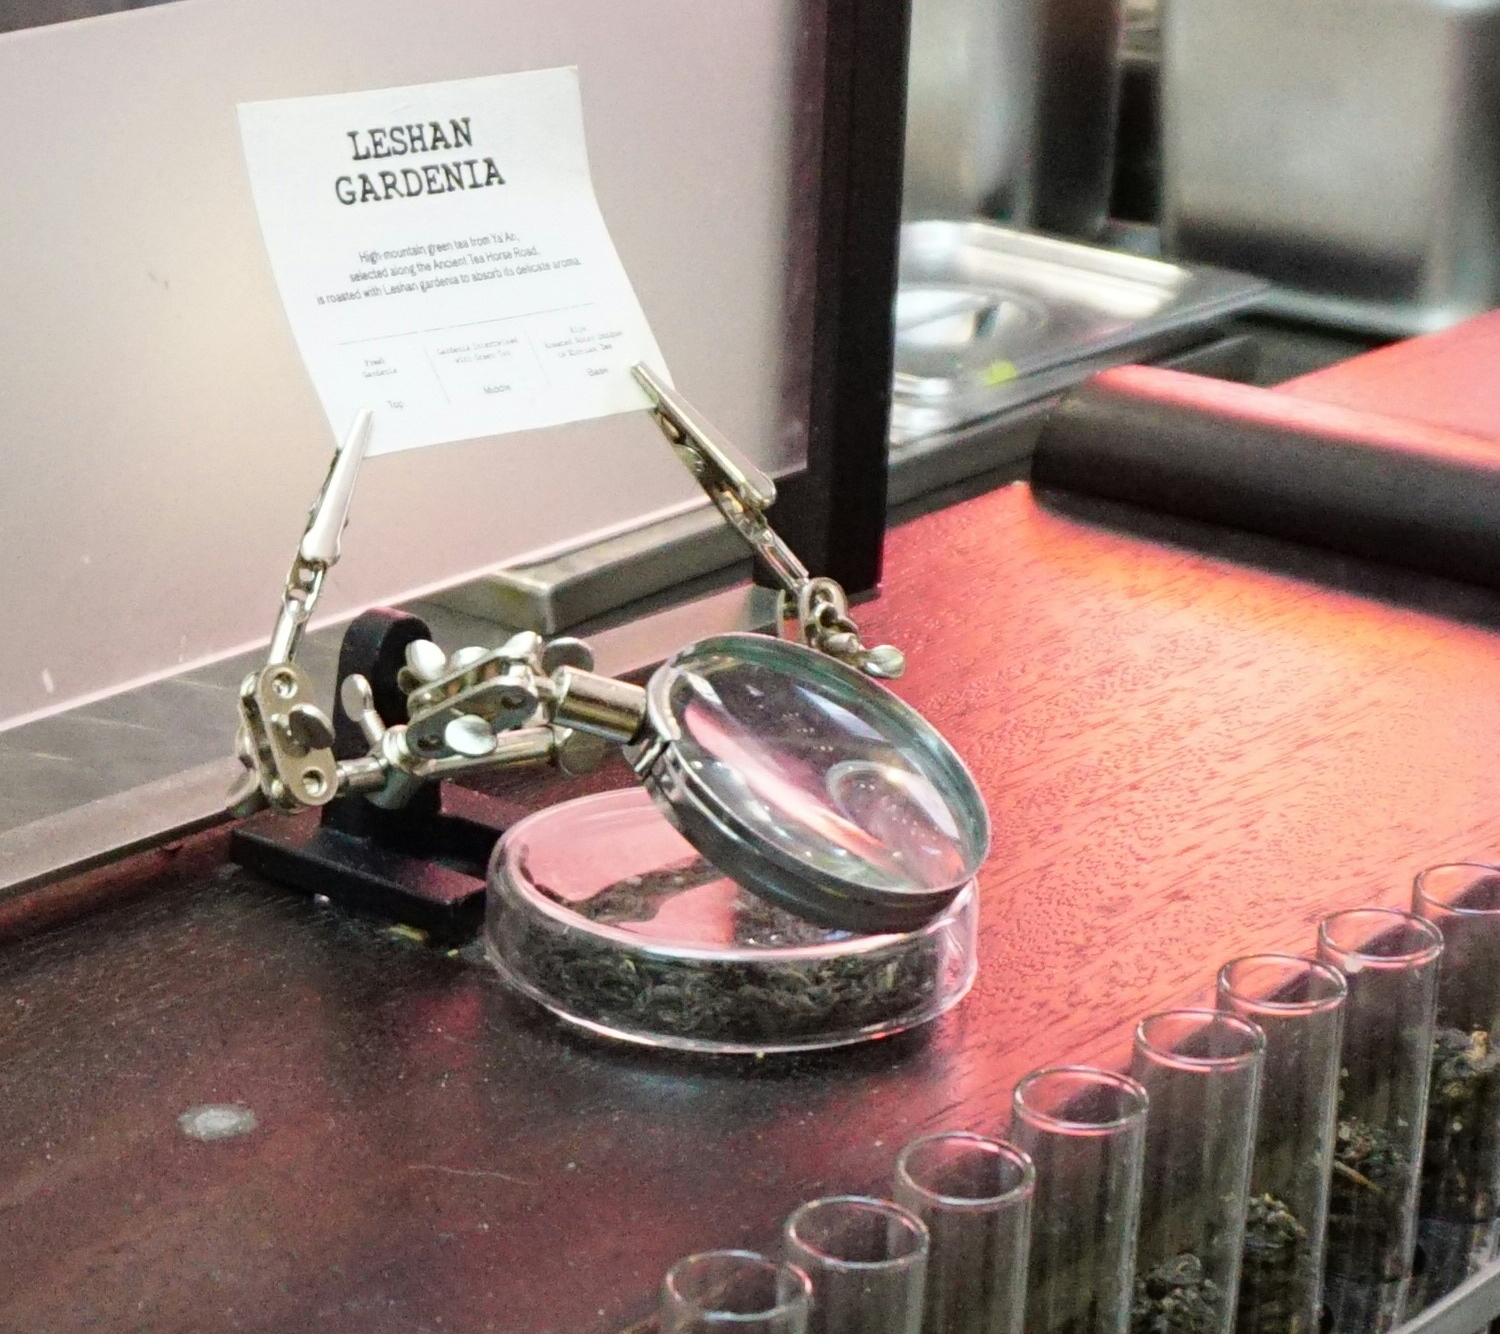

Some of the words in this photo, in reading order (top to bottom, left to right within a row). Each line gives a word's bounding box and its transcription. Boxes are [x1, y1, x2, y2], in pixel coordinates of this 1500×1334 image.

[346, 117, 472, 161] LESHAN
[335, 157, 506, 206] GARDENIA
[349, 267, 388, 283] selected
[390, 263, 417, 277] along
[417, 261, 432, 272] the
[433, 255, 468, 270] Ancient
[467, 252, 485, 265] Tea
[486, 249, 513, 262] Horse
[427, 241, 453, 257] green
[454, 239, 469, 250] tea
[470, 235, 491, 247] from
[316, 294, 326, 305] is
[326, 288, 362, 304] roasted
[363, 284, 383, 298] with
[383, 281, 419, 296] Leshan
[419, 275, 460, 293] gardenia
[460, 272, 470, 283] to
[471, 267, 502, 282] absorb
[516, 261, 551, 276] delicate
